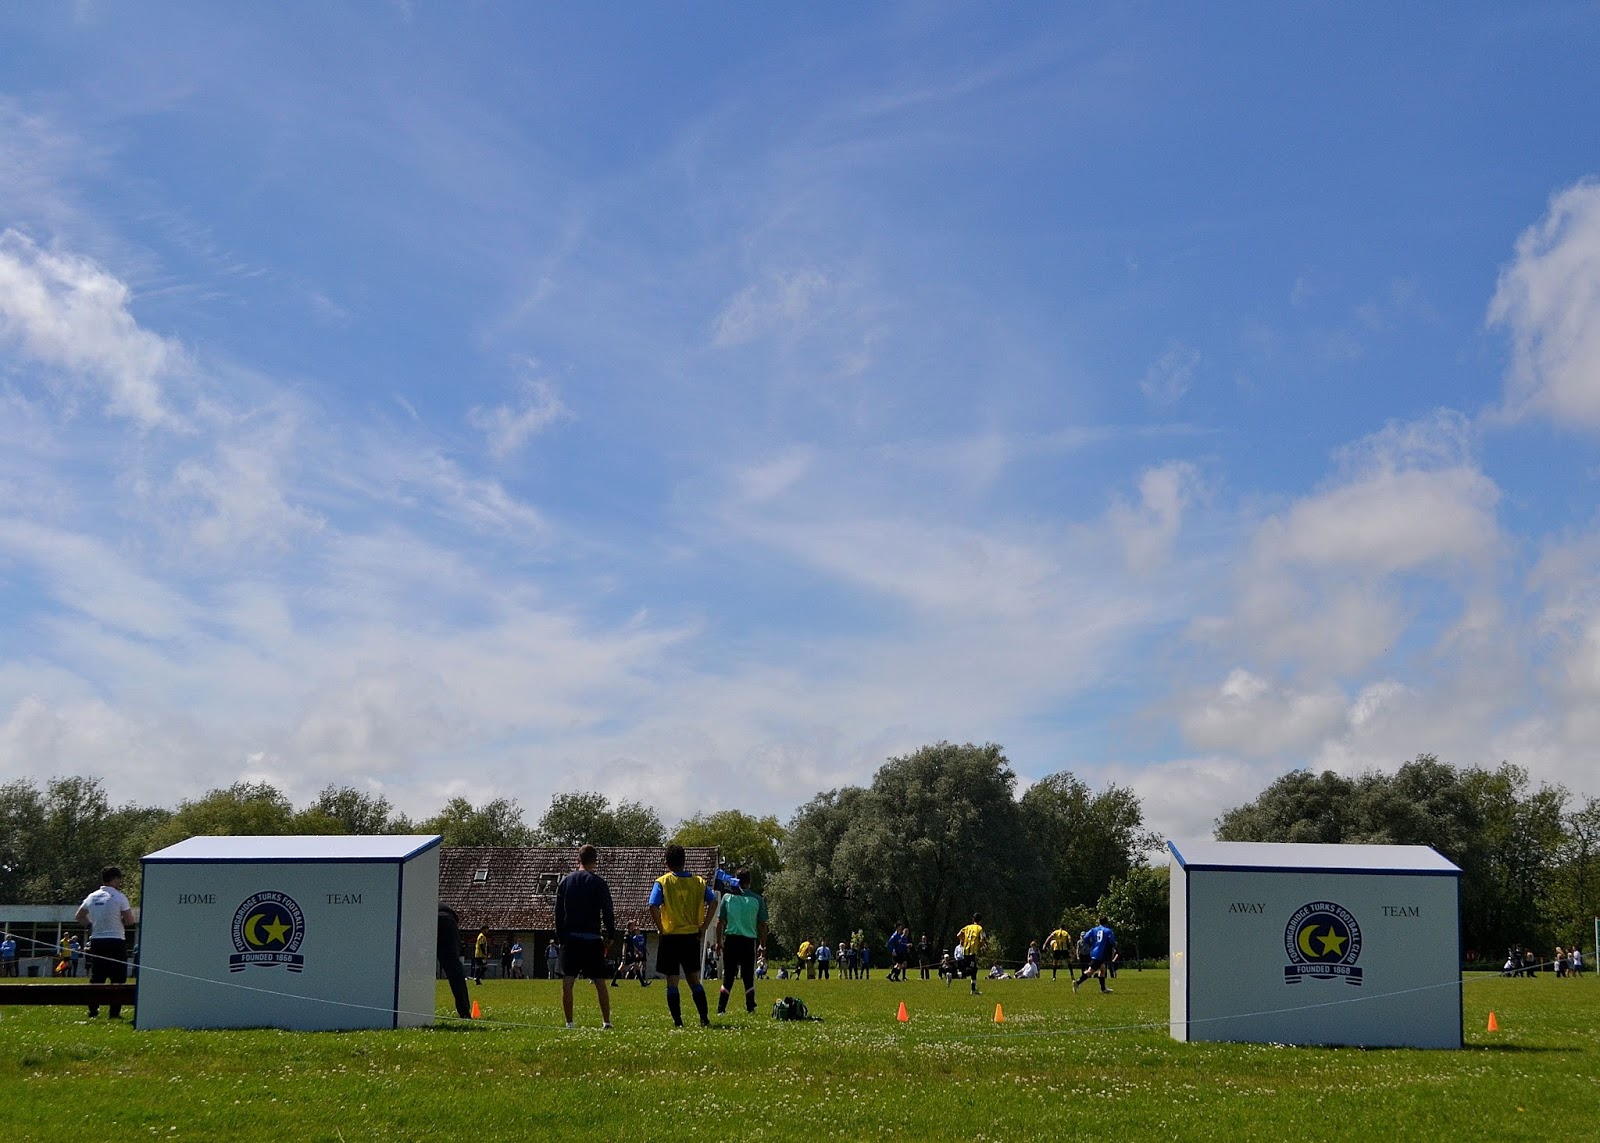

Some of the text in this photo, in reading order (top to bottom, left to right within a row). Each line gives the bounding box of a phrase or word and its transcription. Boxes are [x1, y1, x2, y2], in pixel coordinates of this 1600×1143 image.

[178, 893, 362, 904] HOME TEAM
[1228, 902, 1420, 917] AWAY TEAM
[233, 892, 304, 951] FORDINGBRIDGE TURKS FOOTBALL CLUB
[1097, 930, 1103, 942] 9
[1286, 903, 1360, 964] FORDINGBRIDGE TURKS FOOTBALL CLUB
[241, 952, 293, 962] FOUNDED 1868
[1297, 965, 1350, 975] FOUNDED 1868
